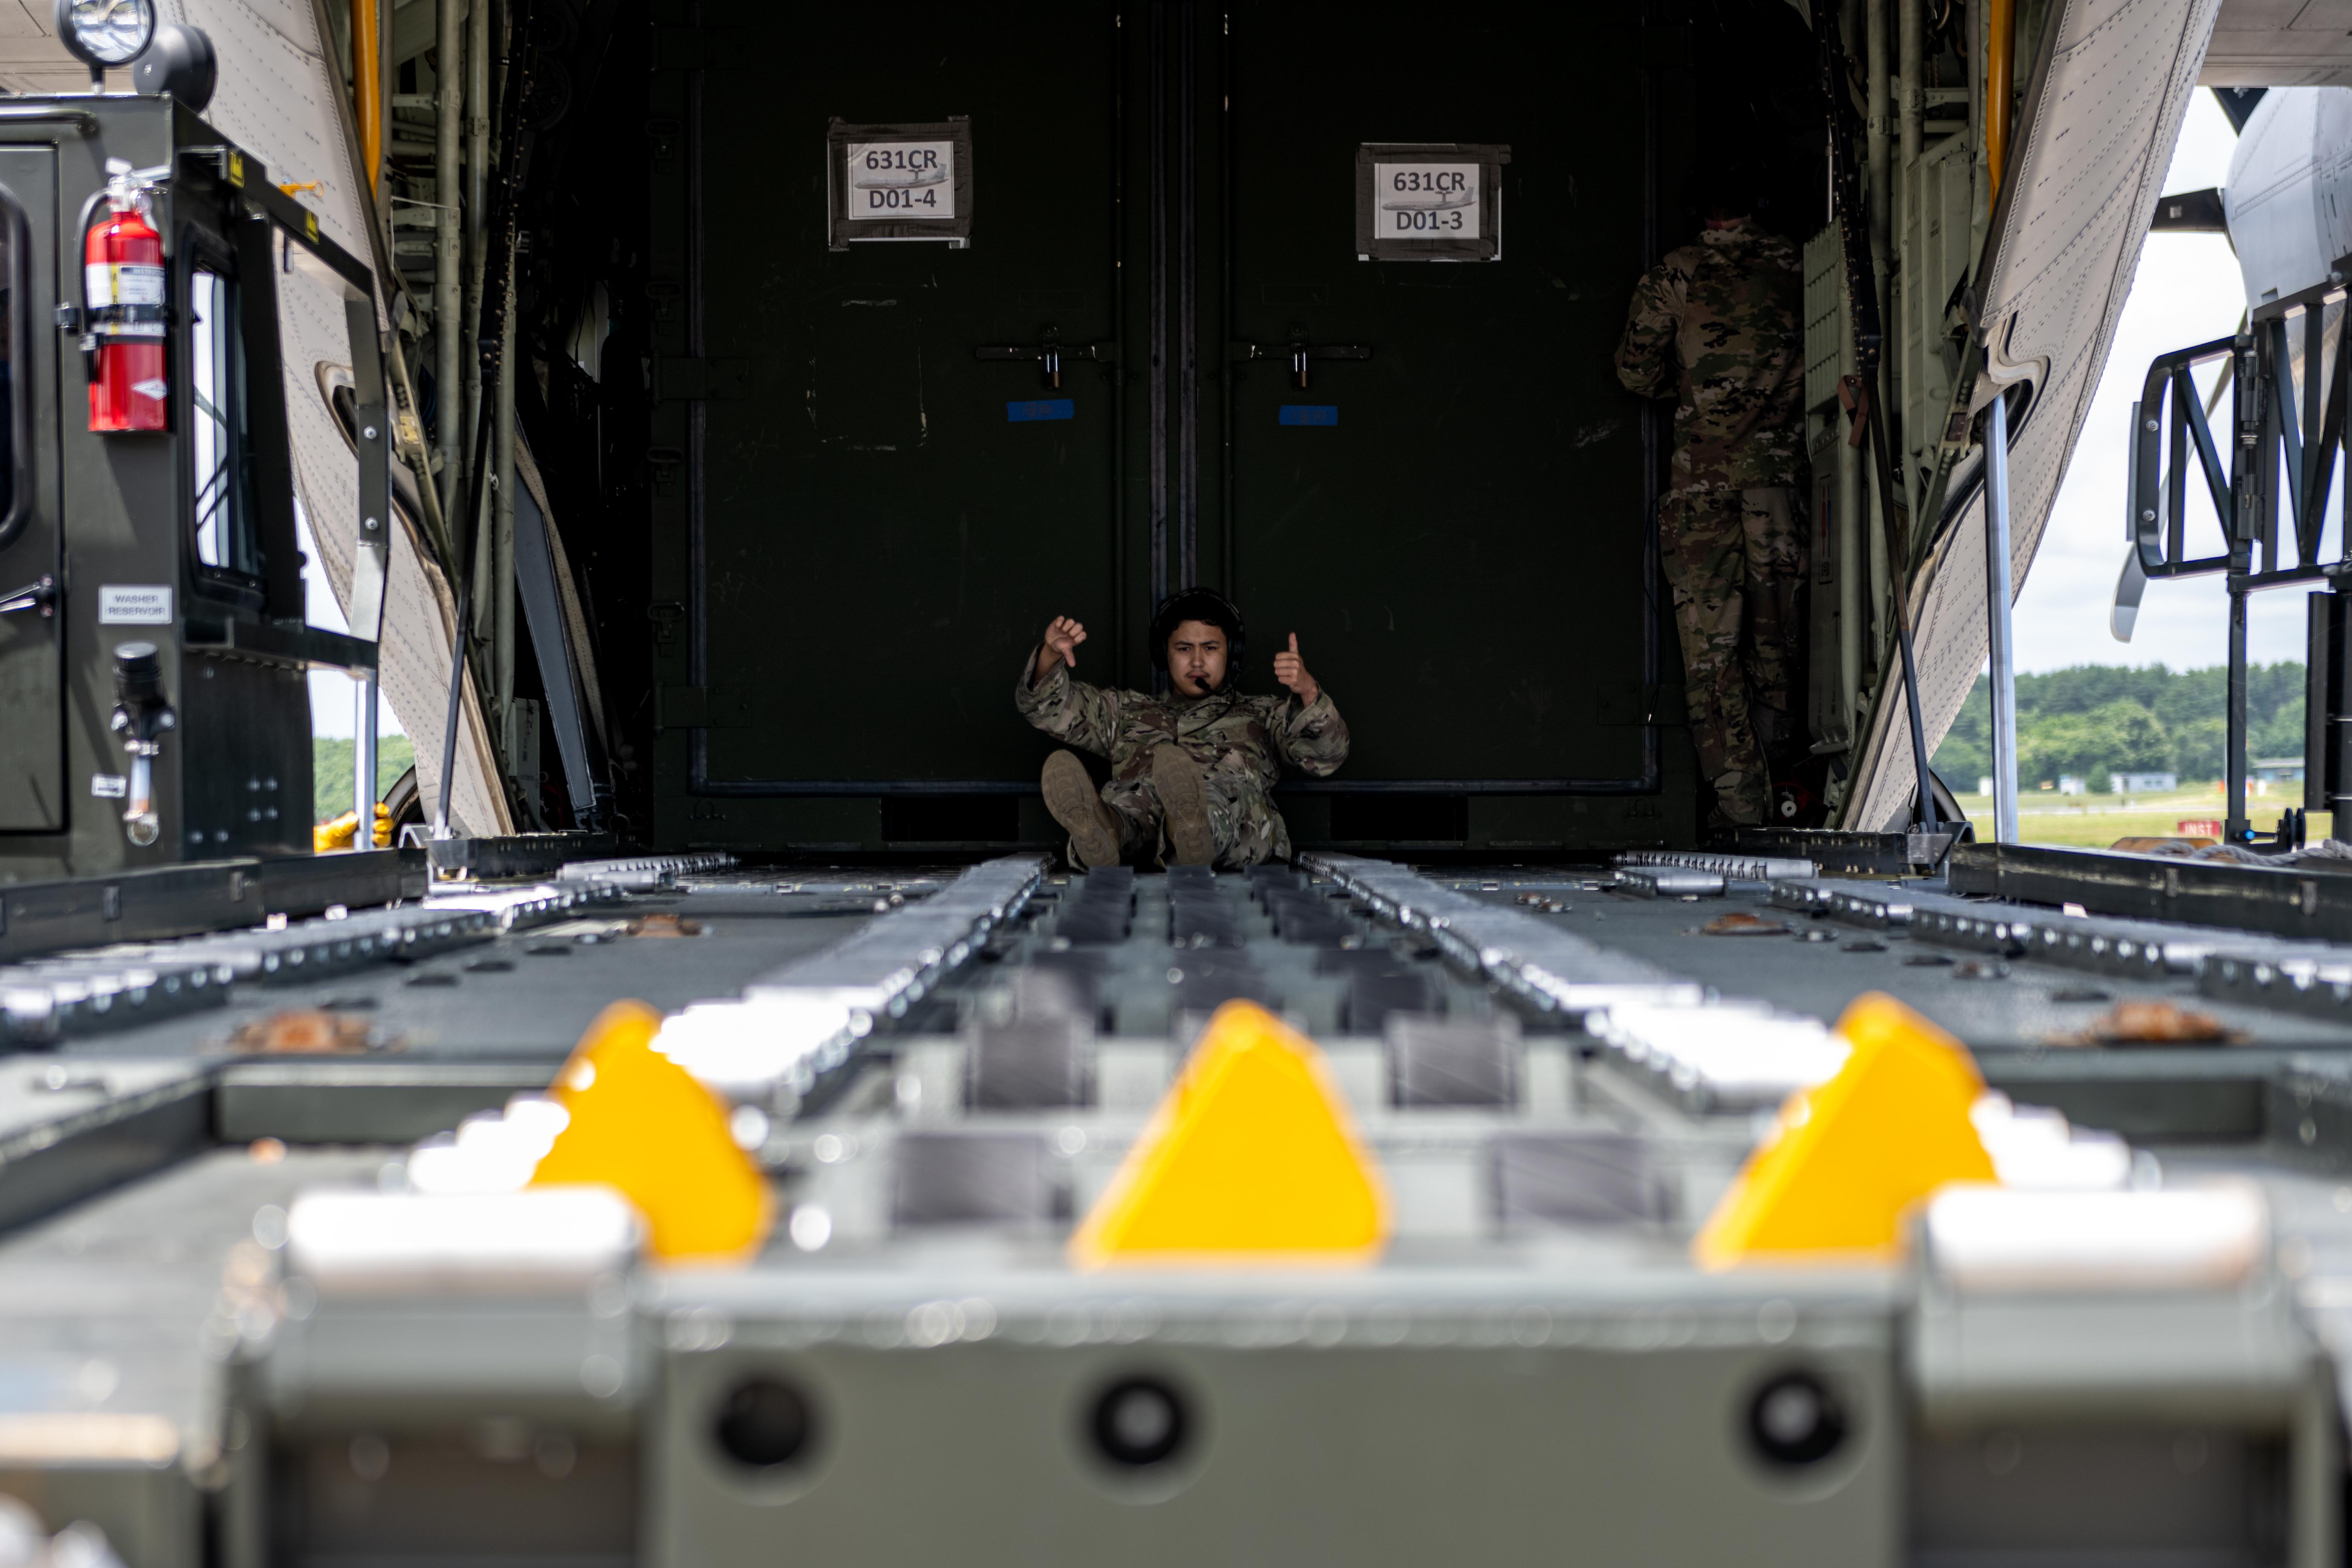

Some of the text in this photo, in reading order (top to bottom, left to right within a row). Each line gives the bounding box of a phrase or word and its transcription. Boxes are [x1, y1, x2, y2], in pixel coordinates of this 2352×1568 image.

[866, 150, 938, 170] 631CR
[1394, 172, 1465, 191] 631CR
[869, 189, 937, 208] D01-4
[1397, 211, 1463, 230] D01-3
[115, 595, 158, 603] WASHER
[2185, 823, 2213, 836] INST
